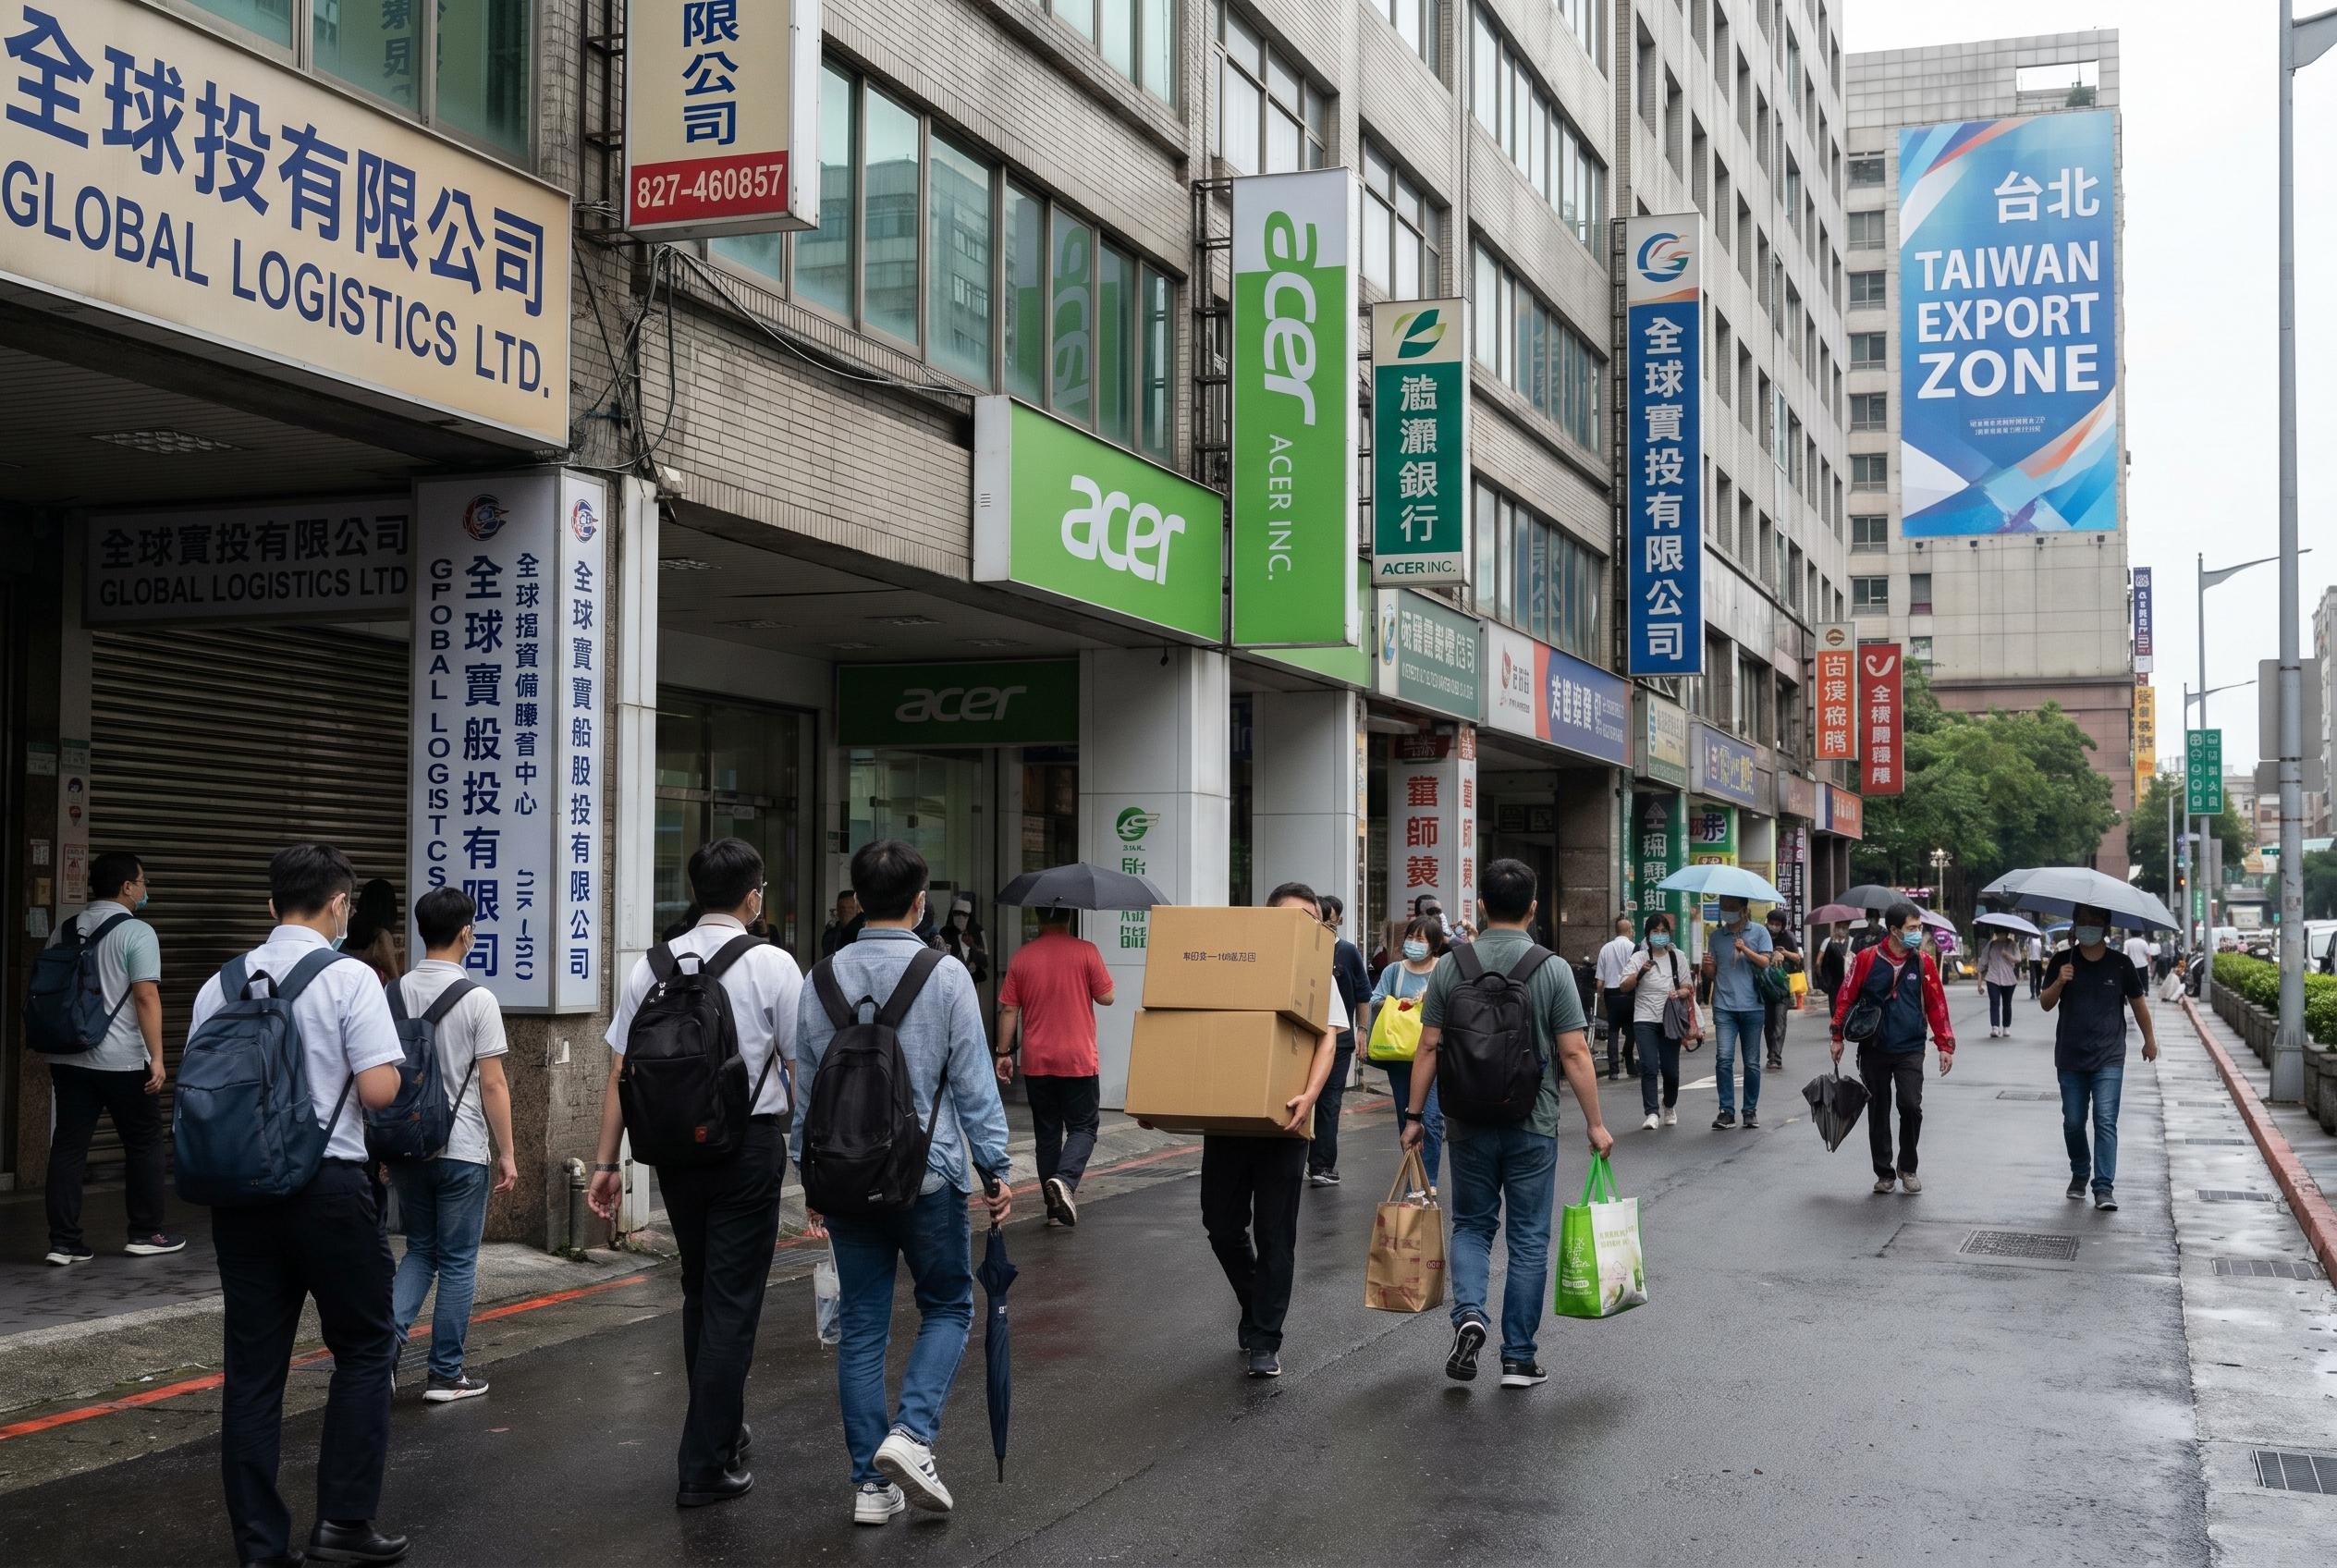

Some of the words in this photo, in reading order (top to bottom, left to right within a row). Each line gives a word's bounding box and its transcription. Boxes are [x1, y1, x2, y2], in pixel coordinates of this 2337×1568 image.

[682, 0, 740, 146] 限公司
[4, 5, 544, 317] 全球投有限公司
[637, 164, 783, 208] 827-460857
[1994, 167, 2099, 224] 台北
[3, 160, 209, 287] GLOBAL
[233, 239, 457, 366] LOGISTICS
[476, 324, 549, 398] LTD.
[1915, 241, 2098, 291] TAIWAN
[1264, 211, 1317, 425] acer
[1918, 292, 2098, 343] EXPORT
[1917, 344, 2099, 399] ZONE
[1268, 434, 1292, 510] ACER
[1645, 318, 1684, 660] 全球實投有限公司
[1061, 474, 1185, 585] acer
[1268, 521, 1291, 580] INC.
[100, 575, 204, 606] GLOBAL
[214, 569, 349, 602] LOGISTICS
[361, 567, 408, 595] LTD
[1381, 561, 1425, 575] ACER
[1427, 559, 1456, 573] INC.
[895, 685, 1027, 723] acer
